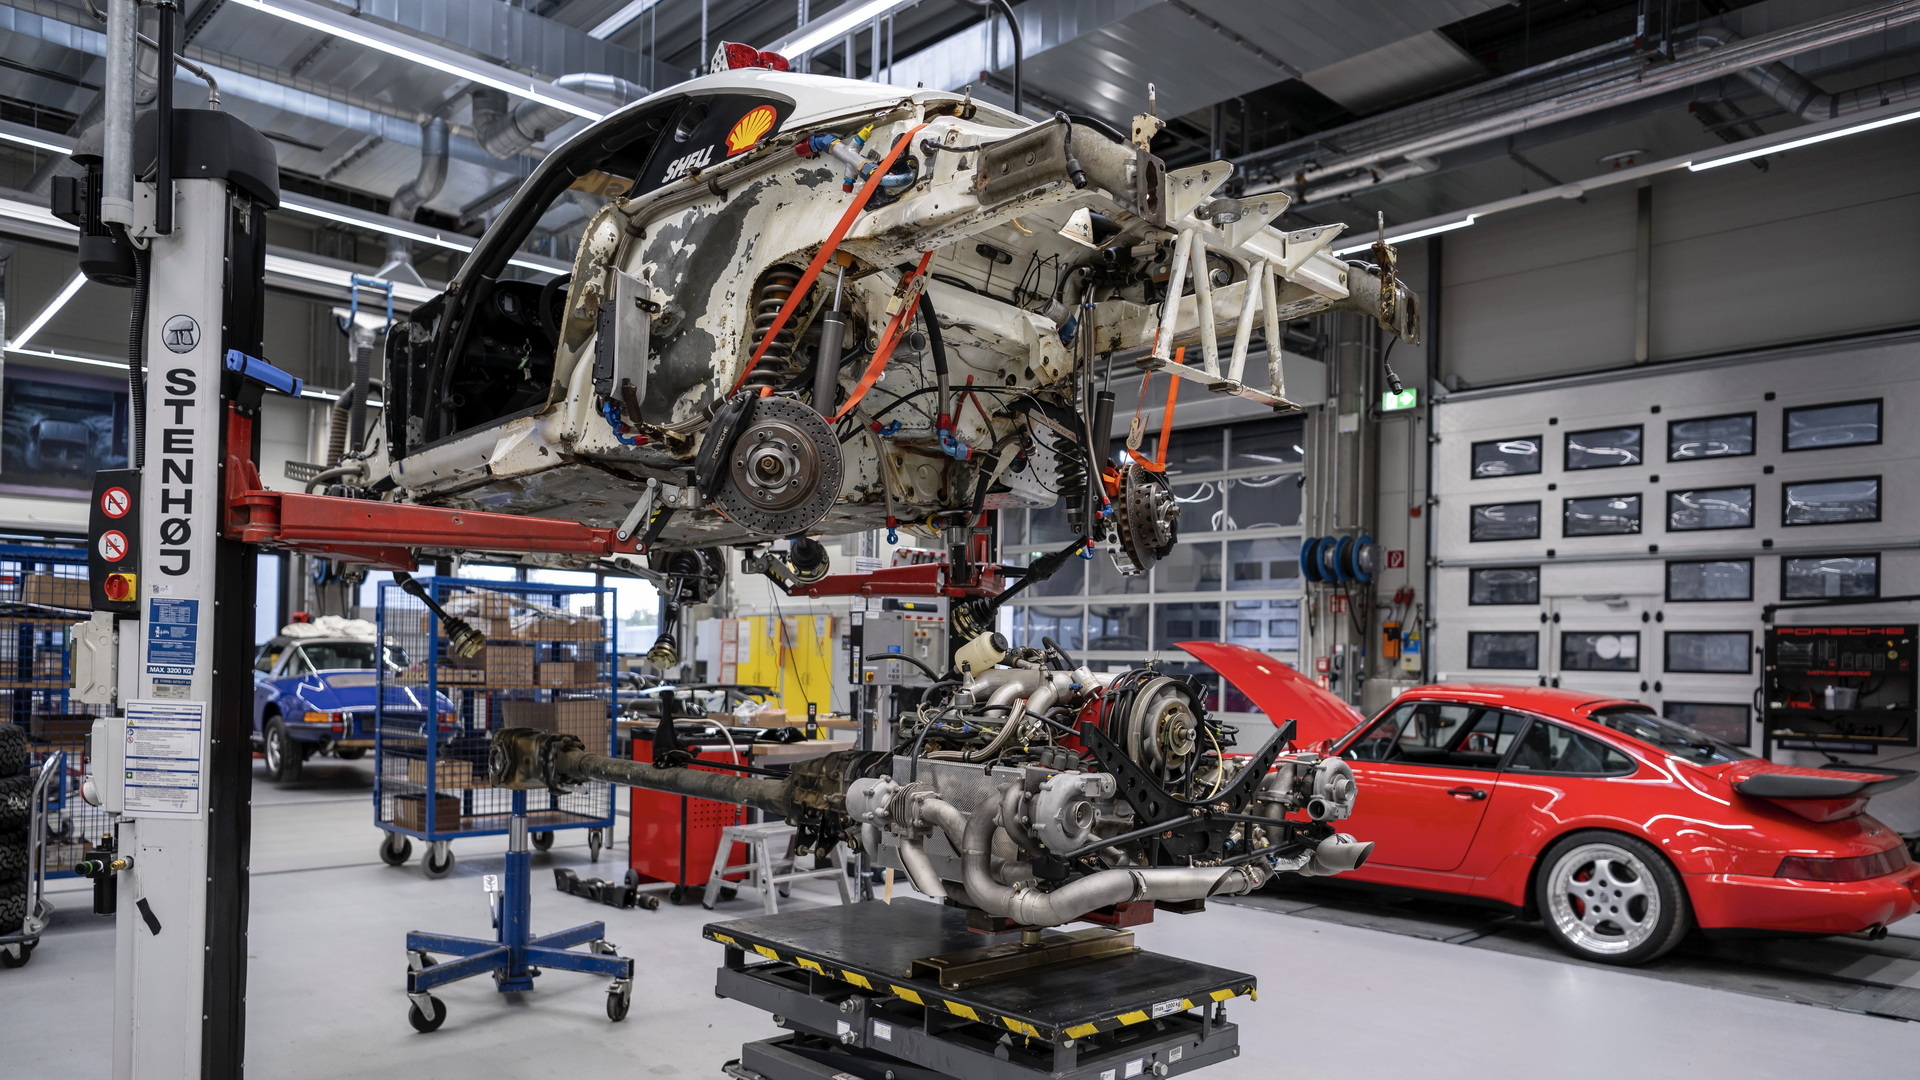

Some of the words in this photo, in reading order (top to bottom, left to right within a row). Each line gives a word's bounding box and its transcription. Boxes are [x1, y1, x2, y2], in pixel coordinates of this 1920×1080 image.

[661, 144, 715, 183] SHELL
[711, 425, 730, 460] PORSCHE
[159, 368, 197, 577] STENHØJ
[1777, 627, 1905, 636] PORSCHE
[1166, 1002, 1175, 1010] 1000
